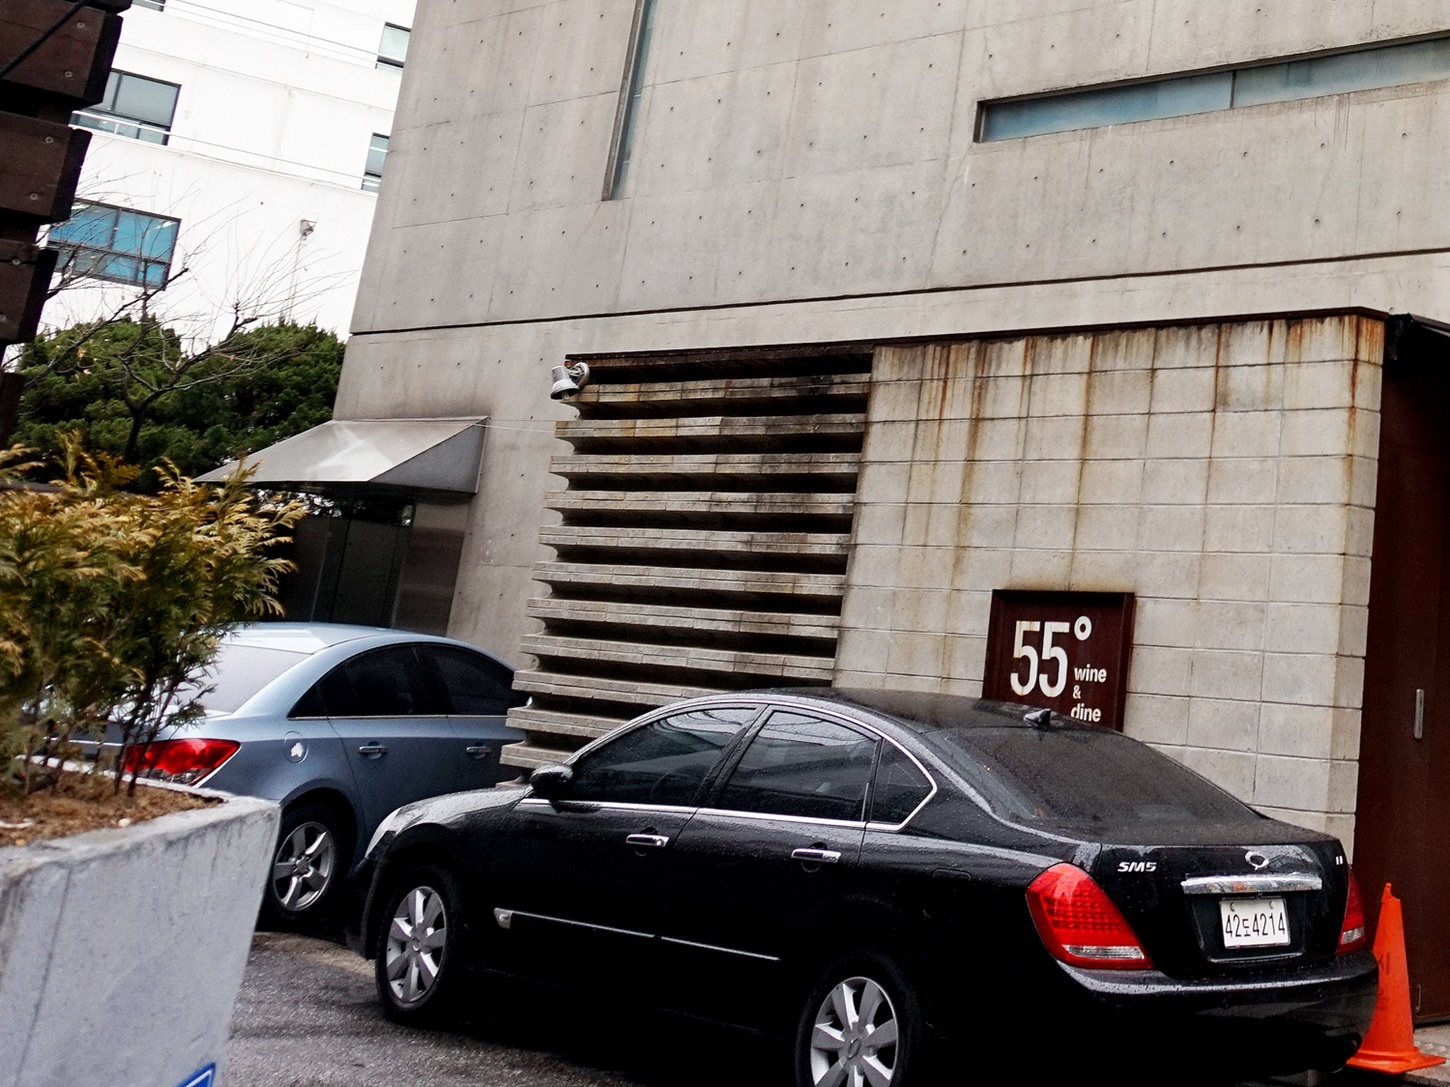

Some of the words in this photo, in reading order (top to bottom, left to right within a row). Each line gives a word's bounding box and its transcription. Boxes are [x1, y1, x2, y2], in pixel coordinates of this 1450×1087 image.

[1074, 664, 1107, 683] wine
[1072, 685, 1081, 700] &
[1070, 703, 1102, 723] dine
[1117, 861, 1157, 873] SM5
